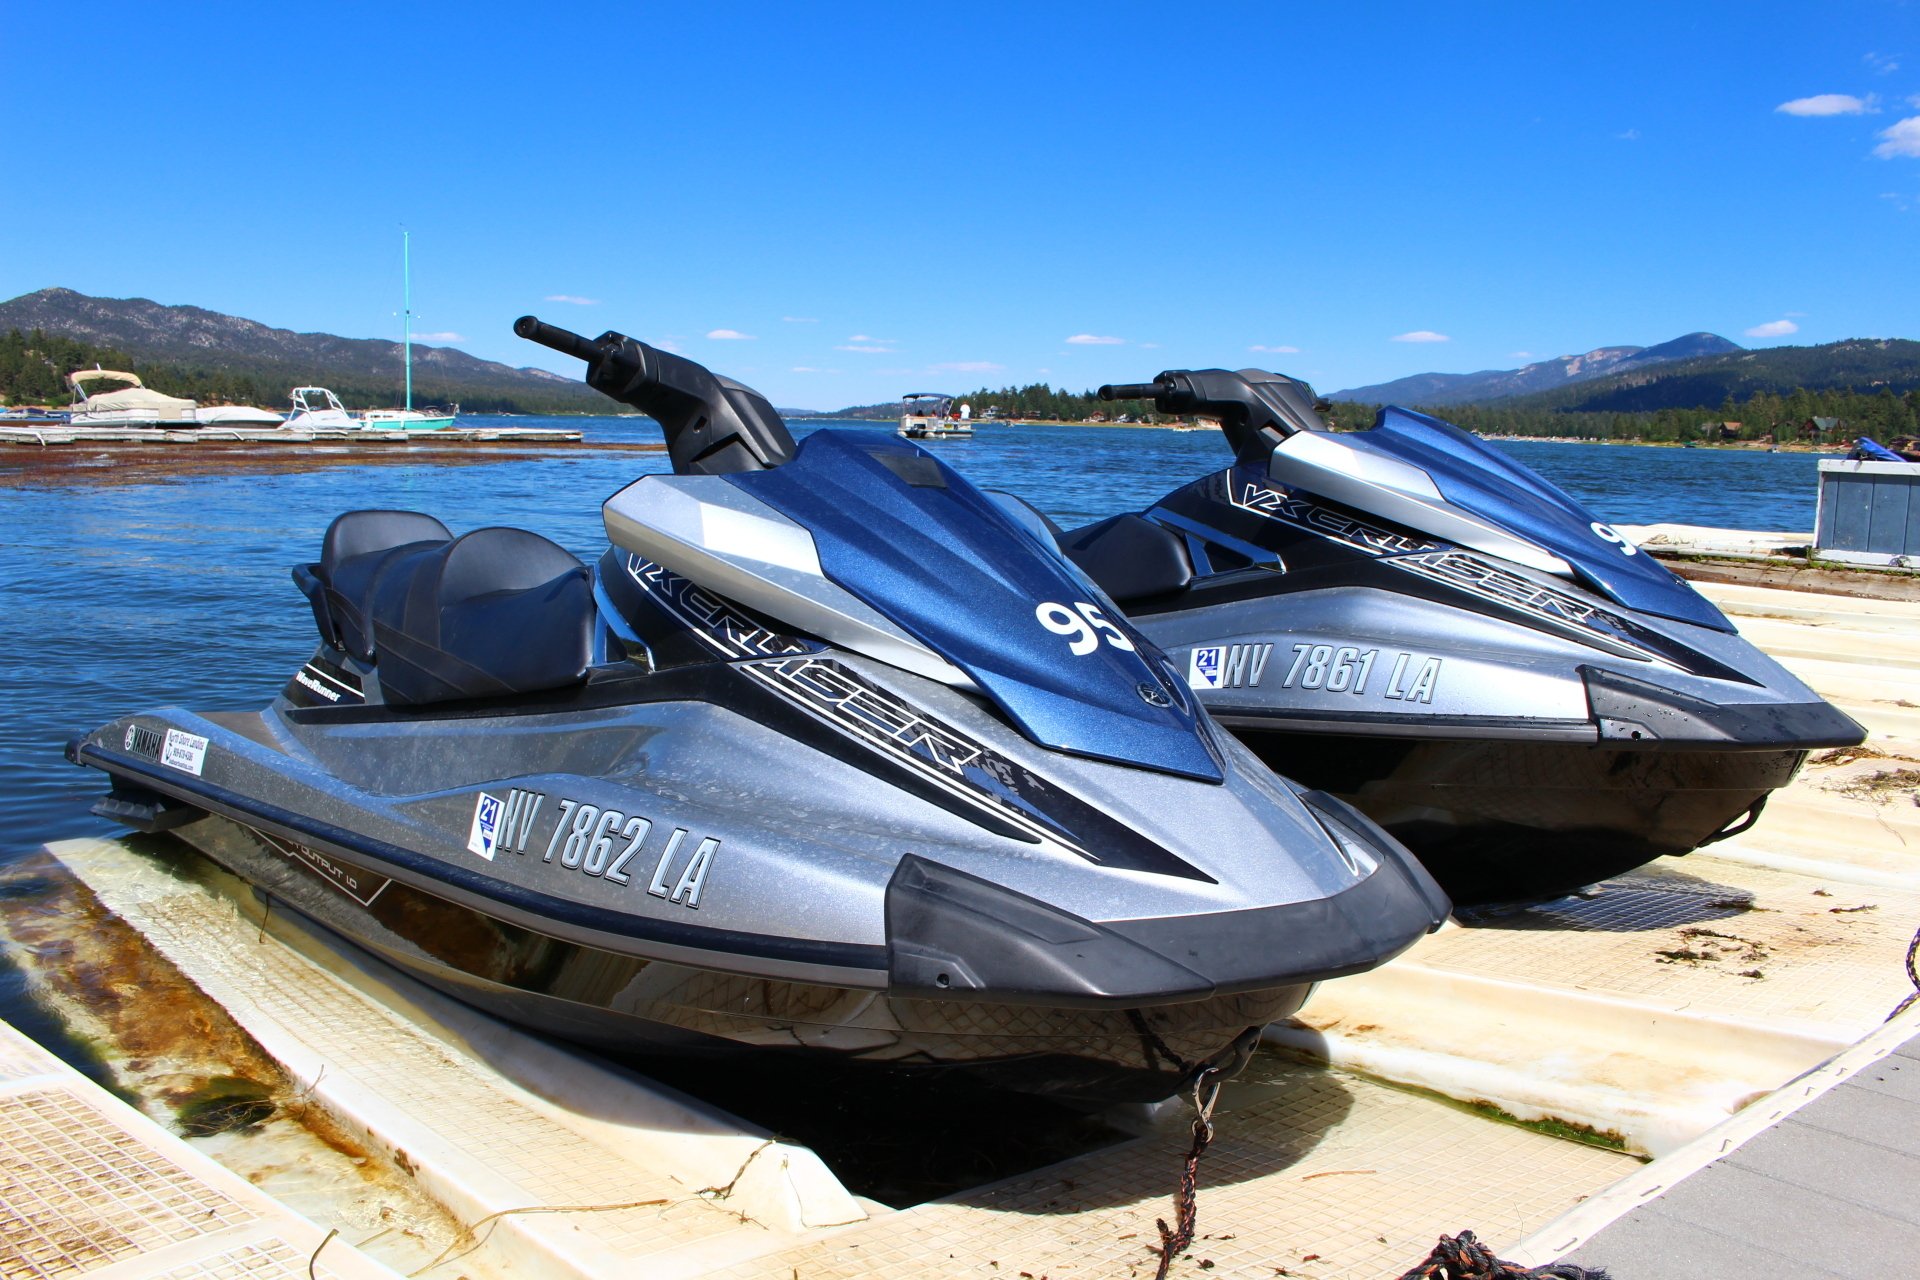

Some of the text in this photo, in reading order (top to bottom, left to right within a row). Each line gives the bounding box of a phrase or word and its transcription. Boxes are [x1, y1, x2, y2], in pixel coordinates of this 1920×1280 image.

[1242, 483, 1312, 518] VX
[1035, 601, 1135, 656] 95
[1197, 648, 1217, 667] 21
[1222, 643, 1443, 705] NV 7861 LA
[295, 670, 342, 703] WaveRunner
[132, 726, 163, 761] YAMAHA
[480, 798, 498, 825] 21
[300, 844, 344, 878] OUTPUT
[496, 787, 722, 910] NV 7862 LA
